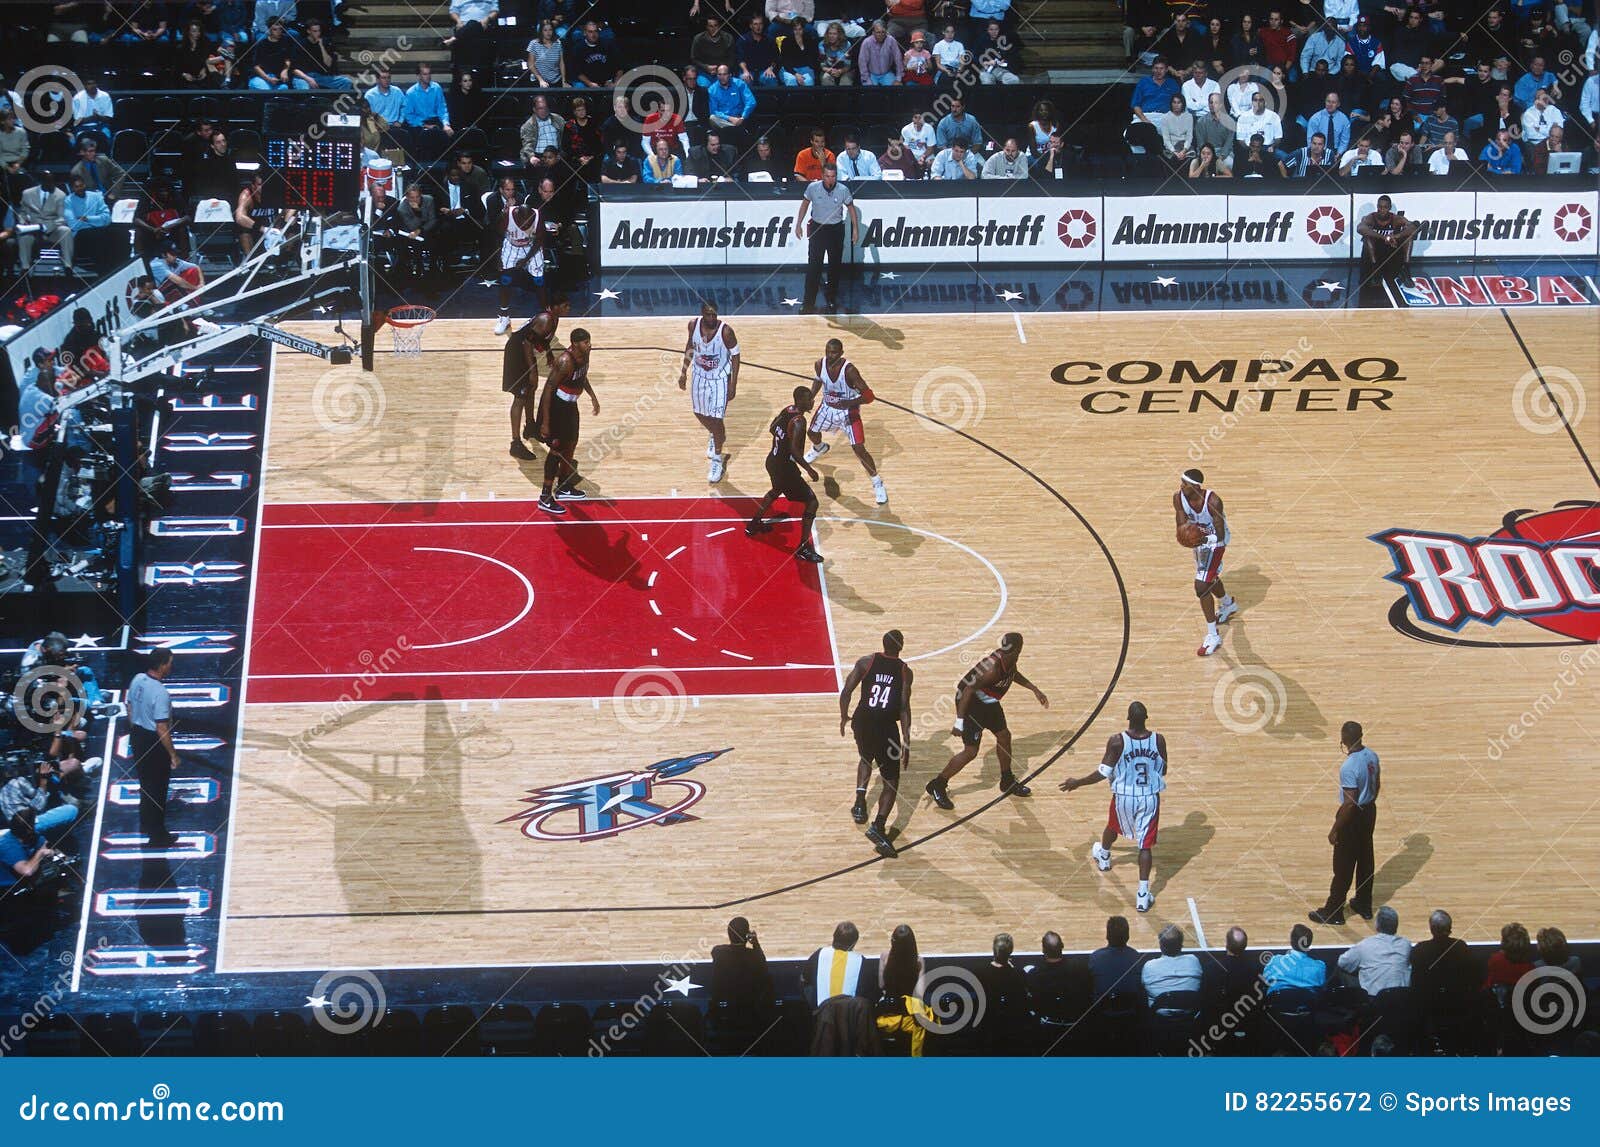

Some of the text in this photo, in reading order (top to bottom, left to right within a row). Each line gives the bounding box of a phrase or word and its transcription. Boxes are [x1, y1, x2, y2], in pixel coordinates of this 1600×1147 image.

[608, 216, 794, 250] Administaff
[861, 214, 1046, 248] Administaff
[1112, 211, 1295, 246] Administaff
[1397, 208, 1542, 241] ministaff
[1431, 275, 1591, 305] NBA
[292, 340, 323, 357] CENTER
[1050, 357, 1407, 385] COMPAQ
[1080, 388, 1395, 414] CENTER
[868, 684, 891, 709] 34
[1134, 762, 1149, 786] 3
